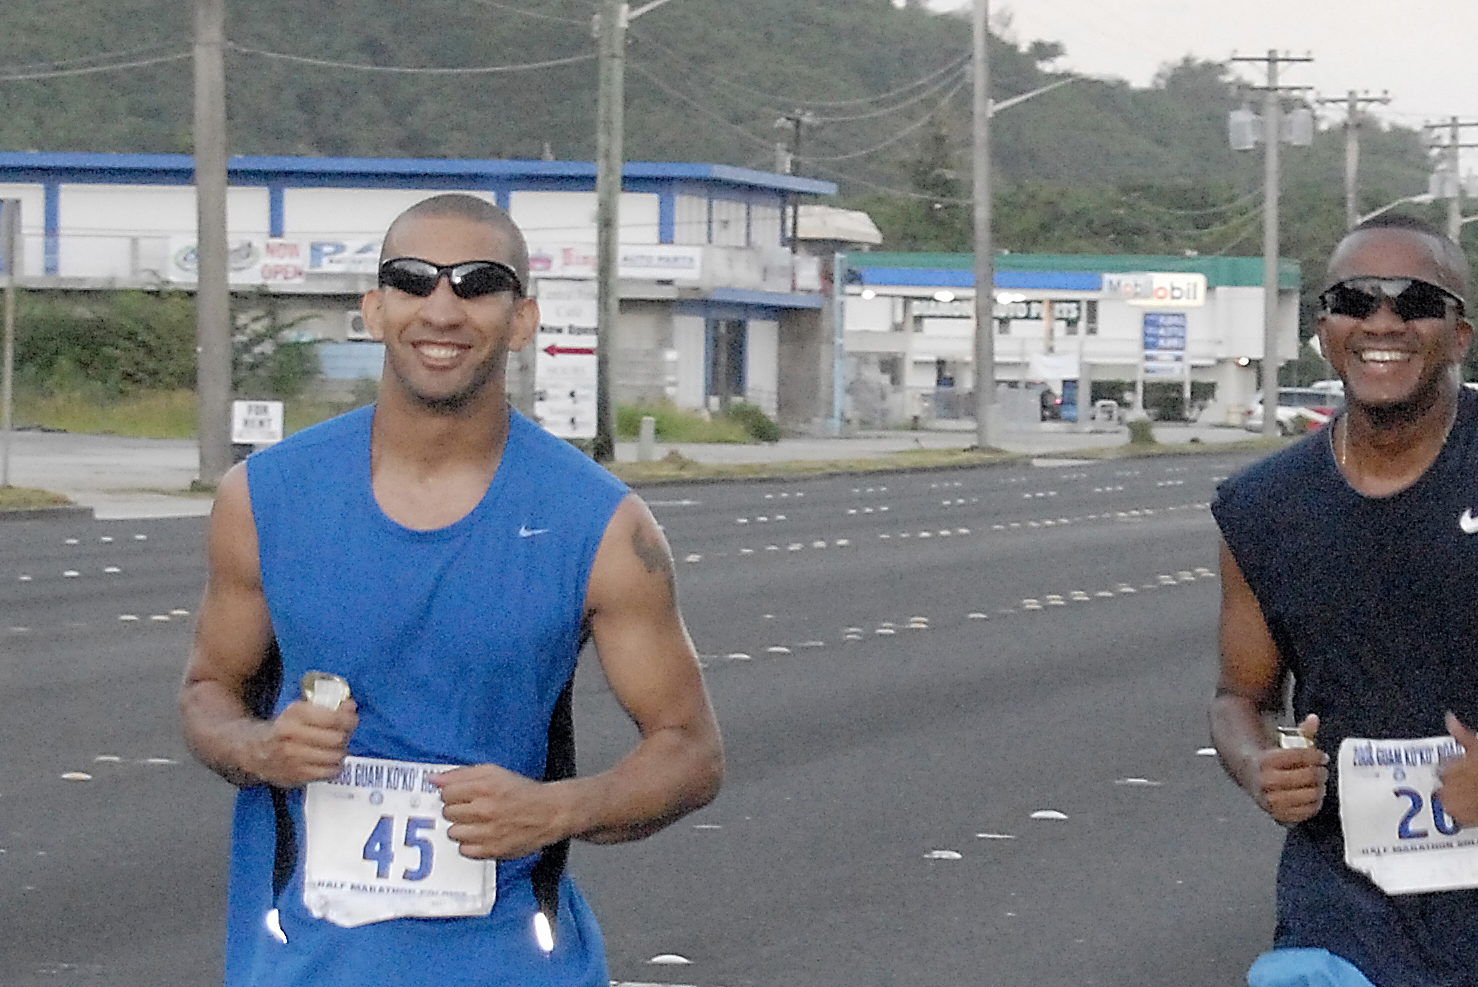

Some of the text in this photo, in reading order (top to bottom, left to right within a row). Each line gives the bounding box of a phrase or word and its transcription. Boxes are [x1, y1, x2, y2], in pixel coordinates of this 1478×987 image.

[266, 242, 300, 258] NOW
[657, 254, 695, 268] PARTS
[261, 263, 303, 280] OPEN
[1153, 281, 1198, 300] obil
[247, 404, 269, 416] FOR
[243, 418, 272, 429] RENT
[1376, 748, 1403, 767] GUAM
[354, 763, 384, 788] GUAM
[362, 815, 437, 882] 45
[317, 880, 345, 890] HALF
[350, 882, 417, 895] MARATHON
